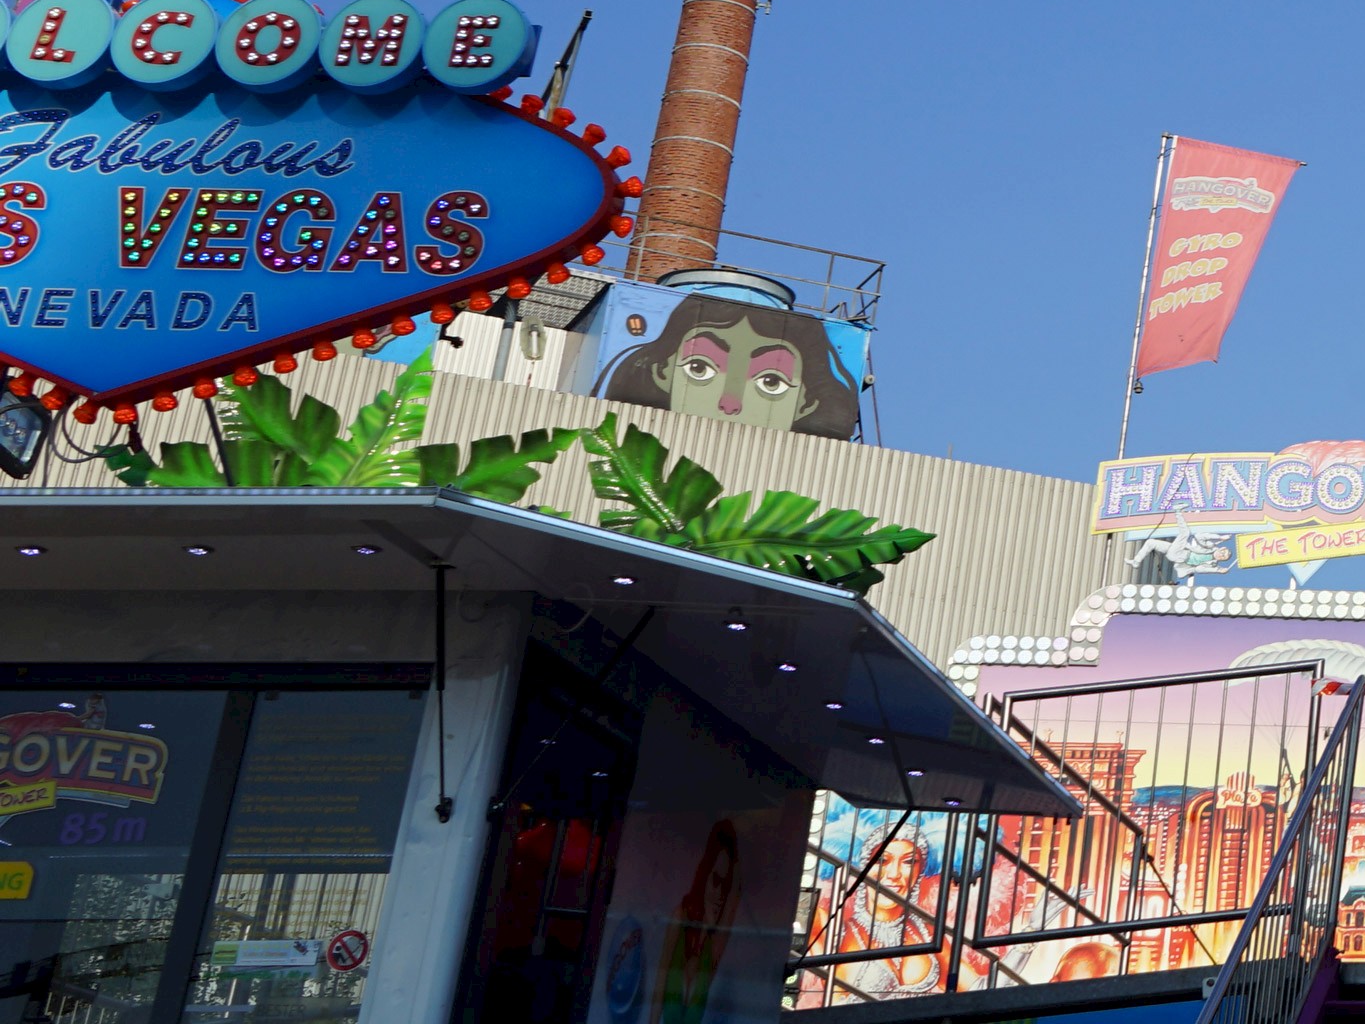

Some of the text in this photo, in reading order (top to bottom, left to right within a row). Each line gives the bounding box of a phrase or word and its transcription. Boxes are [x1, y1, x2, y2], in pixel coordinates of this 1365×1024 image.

[29, 6, 502, 68] LCOME
[1173, 181, 1271, 207] HANGOVER
[117, 184, 490, 275] VEGAS
[1168, 232, 1243, 257] GYRO
[1160, 257, 1229, 288] DROP
[0, 286, 260, 333] NEVADA
[1149, 282, 1223, 321] TOWER
[1245, 534, 1289, 560] THE
[0, 732, 158, 786] OVER
[0, 787, 49, 807] OWER
